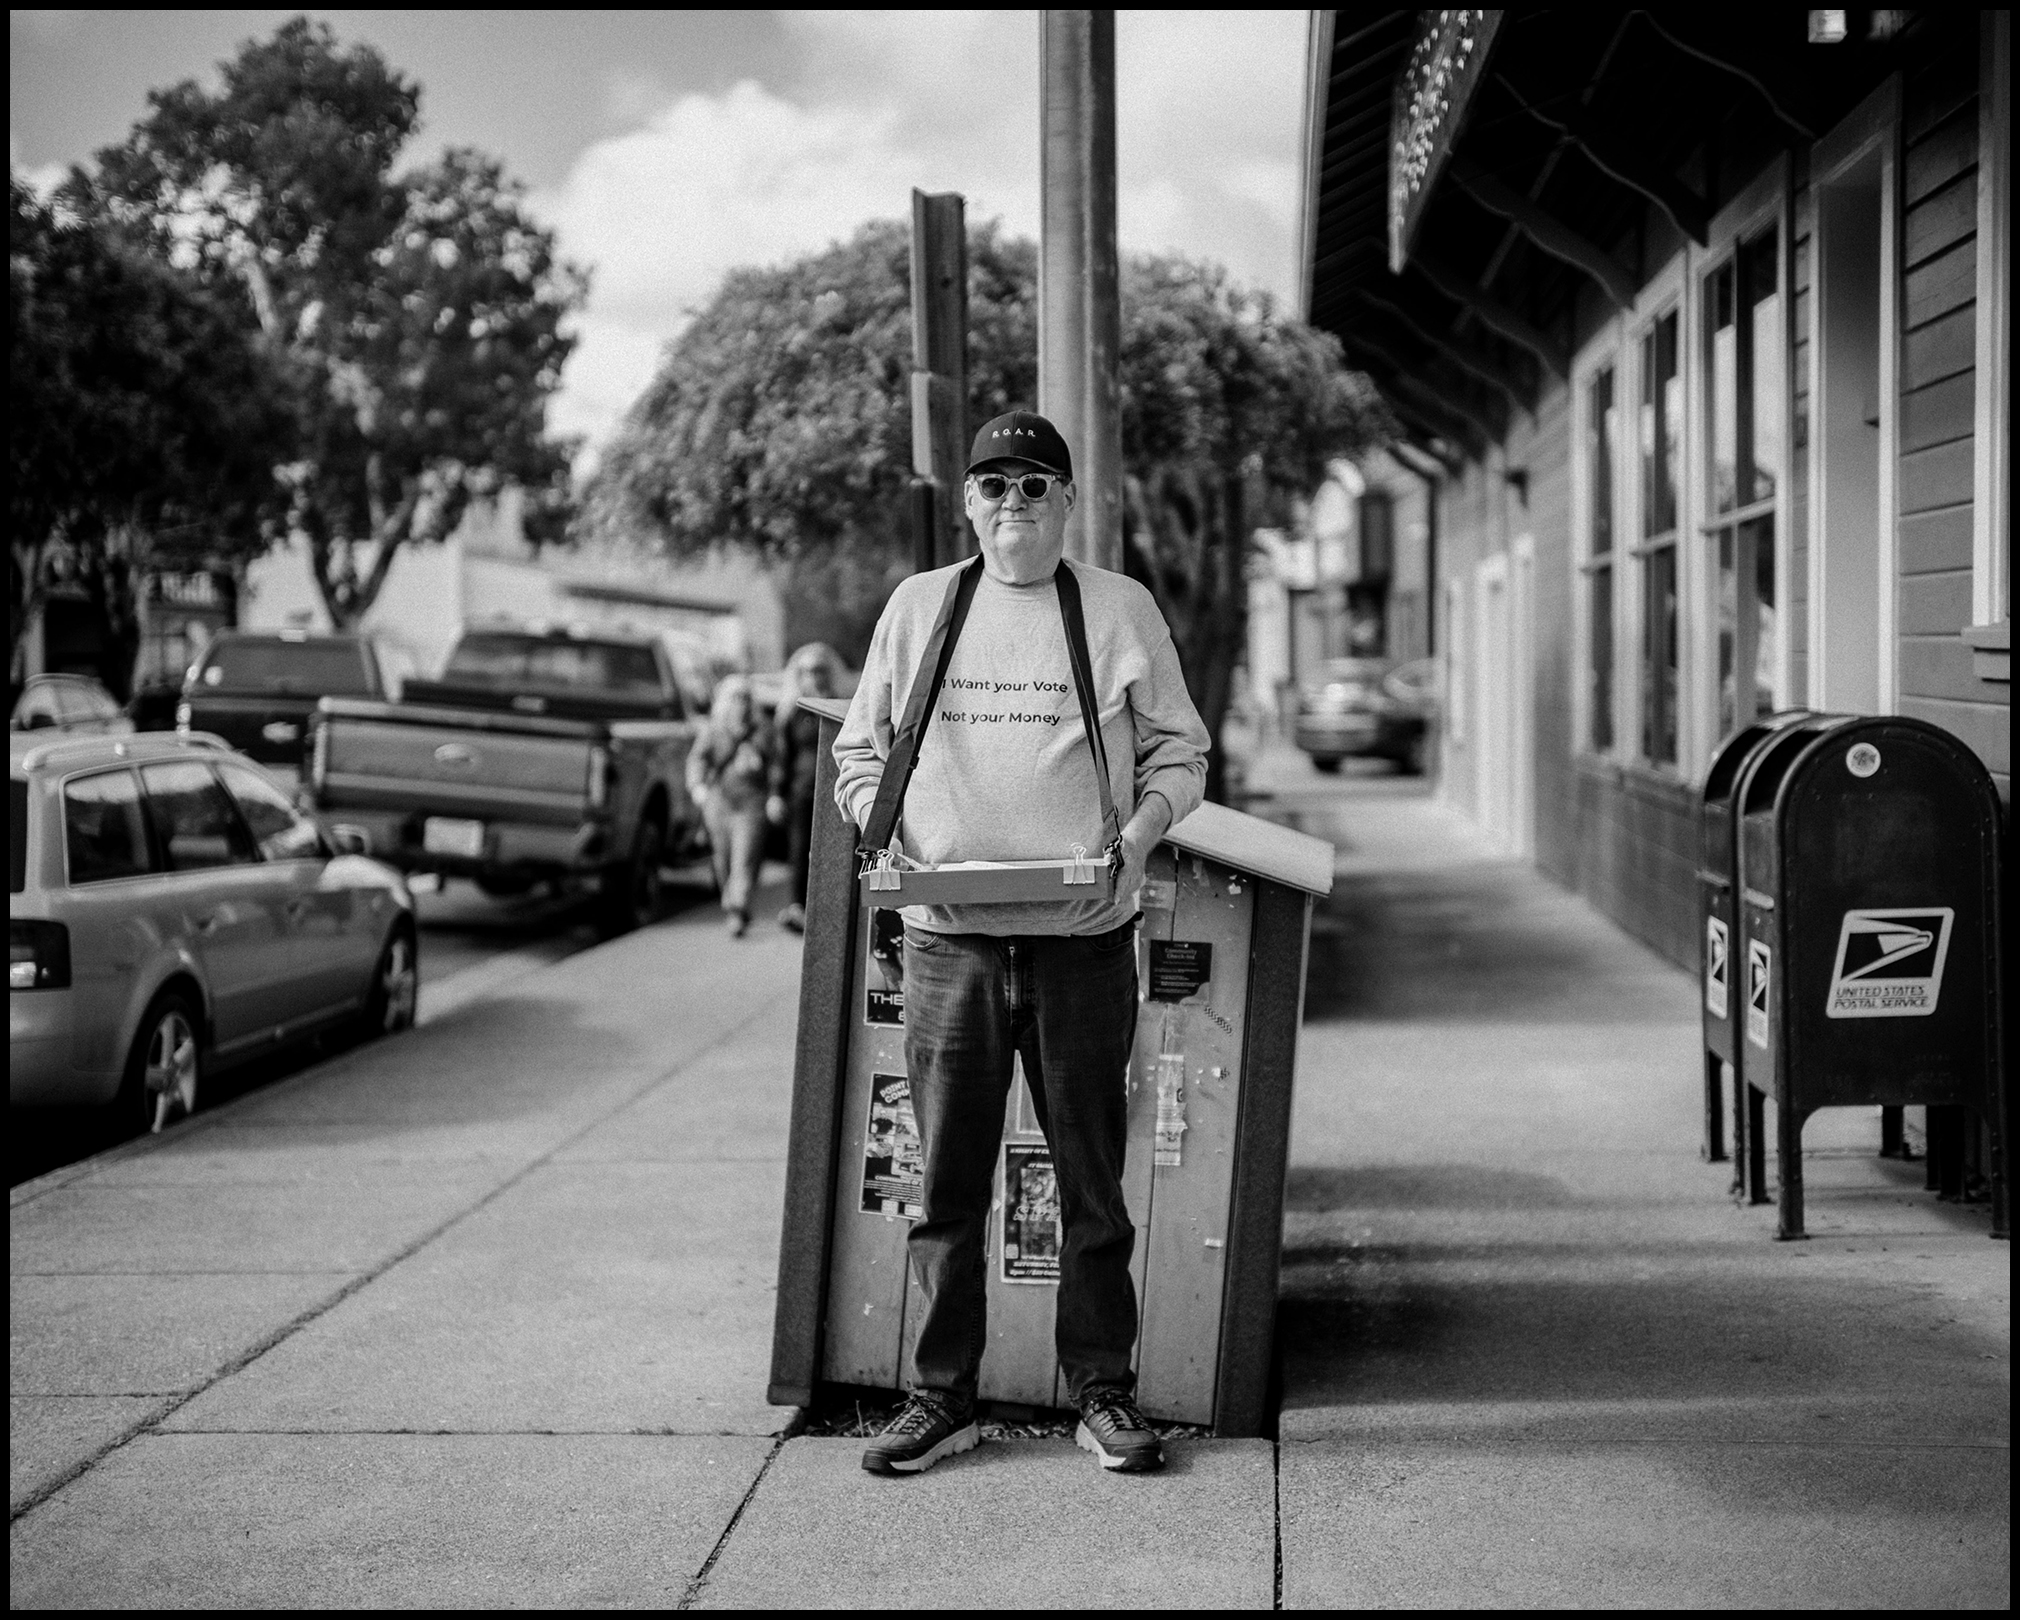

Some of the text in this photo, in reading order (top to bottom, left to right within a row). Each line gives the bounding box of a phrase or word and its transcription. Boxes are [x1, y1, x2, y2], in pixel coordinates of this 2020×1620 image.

[991, 427, 1036, 439] ROAR
[951, 678, 991, 690] Want
[993, 681, 1029, 693] your
[1033, 680, 1068, 693] Vote
[941, 710, 1061, 726] Not your Money
[1836, 984, 1925, 998] UNITED STATES
[1834, 998, 1929, 1010] POSTAL SERVICE
[879, 1080, 906, 1098] POINT
